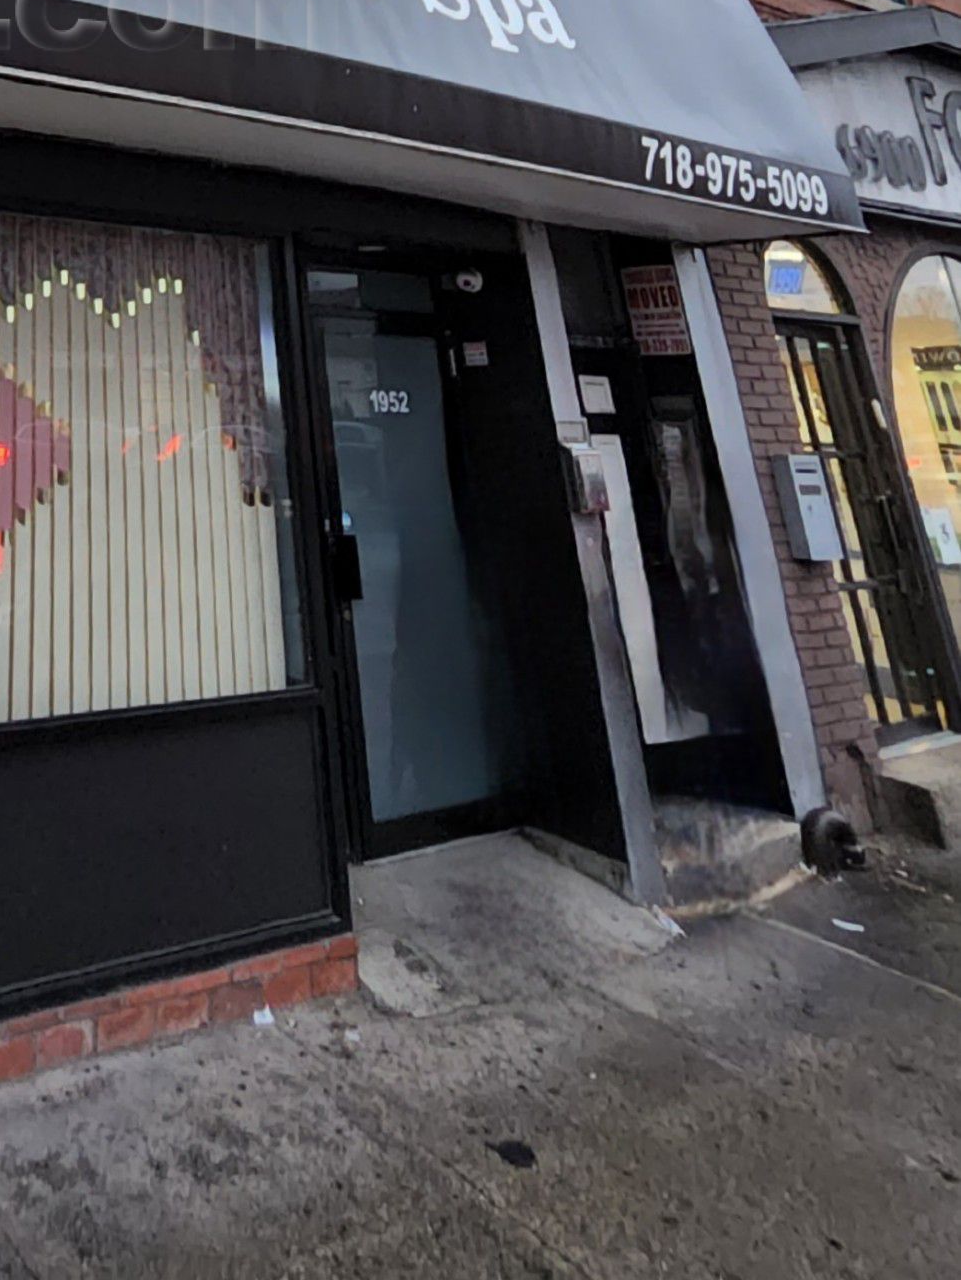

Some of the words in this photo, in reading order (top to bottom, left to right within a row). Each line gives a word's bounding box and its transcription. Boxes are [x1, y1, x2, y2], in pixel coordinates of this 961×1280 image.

[640, 136, 829, 216] 718-975-5099
[627, 285, 680, 309] MOVED
[369, 389, 410, 414] 1952
